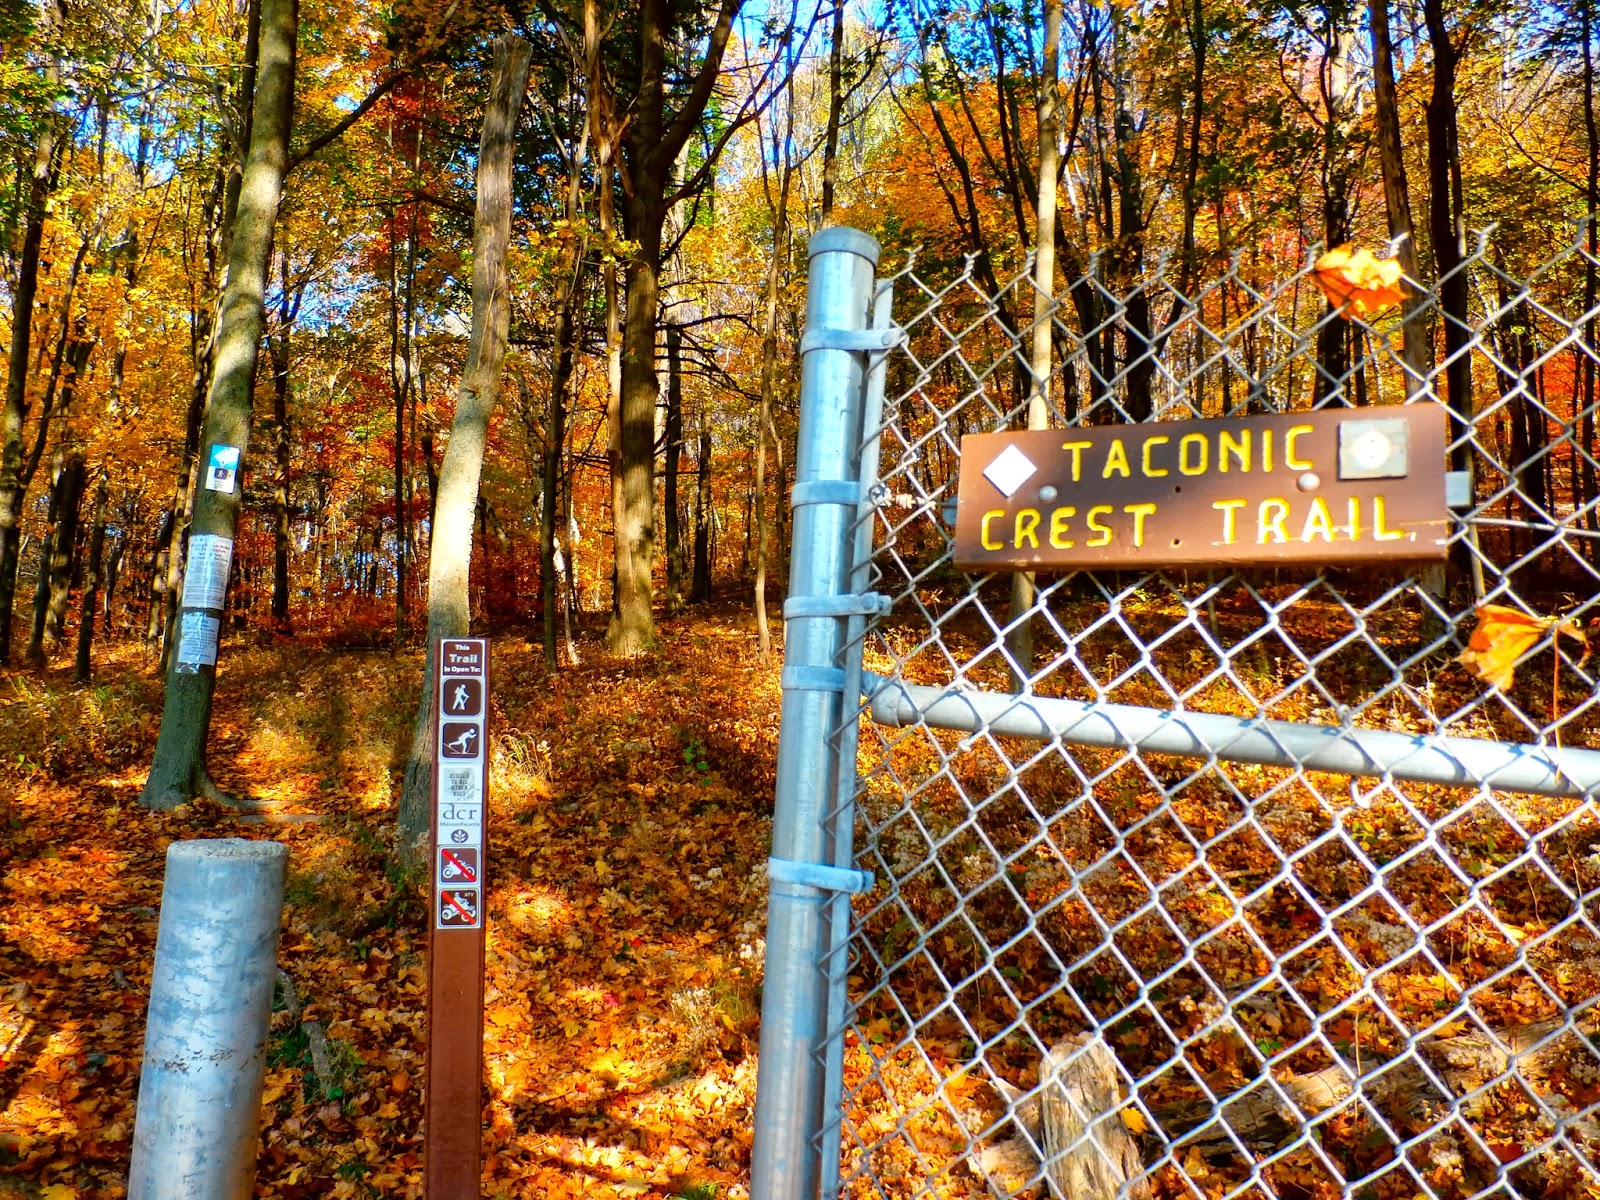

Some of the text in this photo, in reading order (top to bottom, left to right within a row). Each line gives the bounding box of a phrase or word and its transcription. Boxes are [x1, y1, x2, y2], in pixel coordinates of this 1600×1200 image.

[1062, 424, 1315, 482] TACONIC
[981, 495, 1404, 551] CREST TRAIL
[449, 654, 478, 663] Trail
[442, 802, 477, 820] dcr
